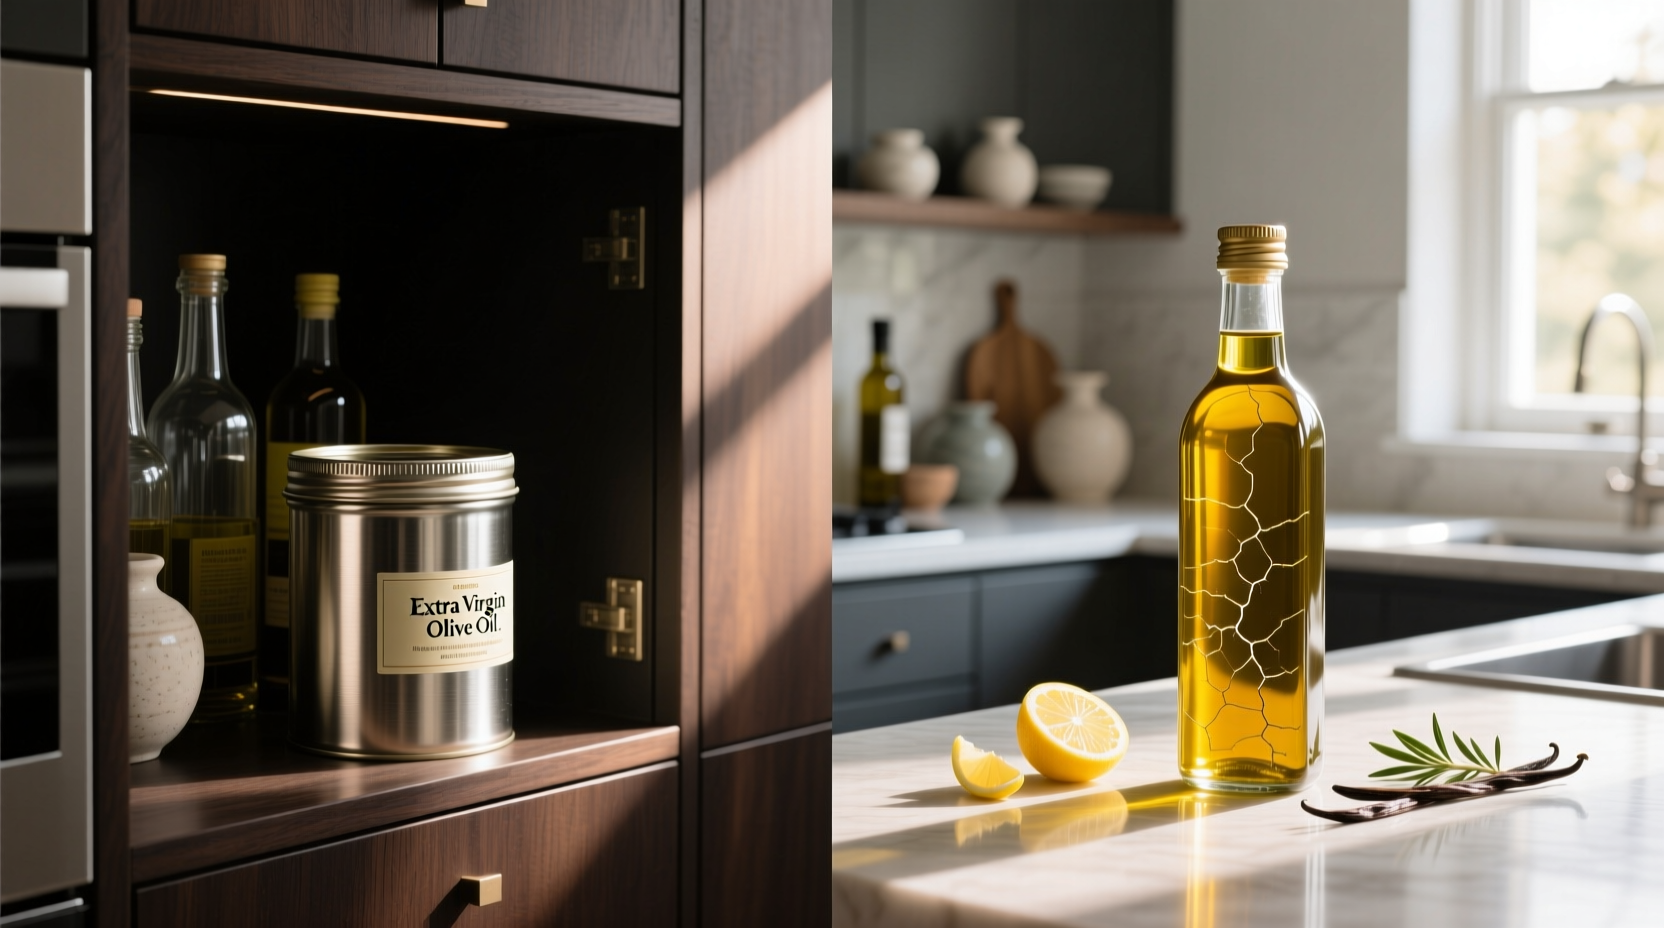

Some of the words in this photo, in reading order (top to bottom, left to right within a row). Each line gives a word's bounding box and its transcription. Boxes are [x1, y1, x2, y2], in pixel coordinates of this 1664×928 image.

[410, 597, 460, 616] Extra
[462, 592, 506, 617] Virgin
[426, 618, 473, 638] Olive
